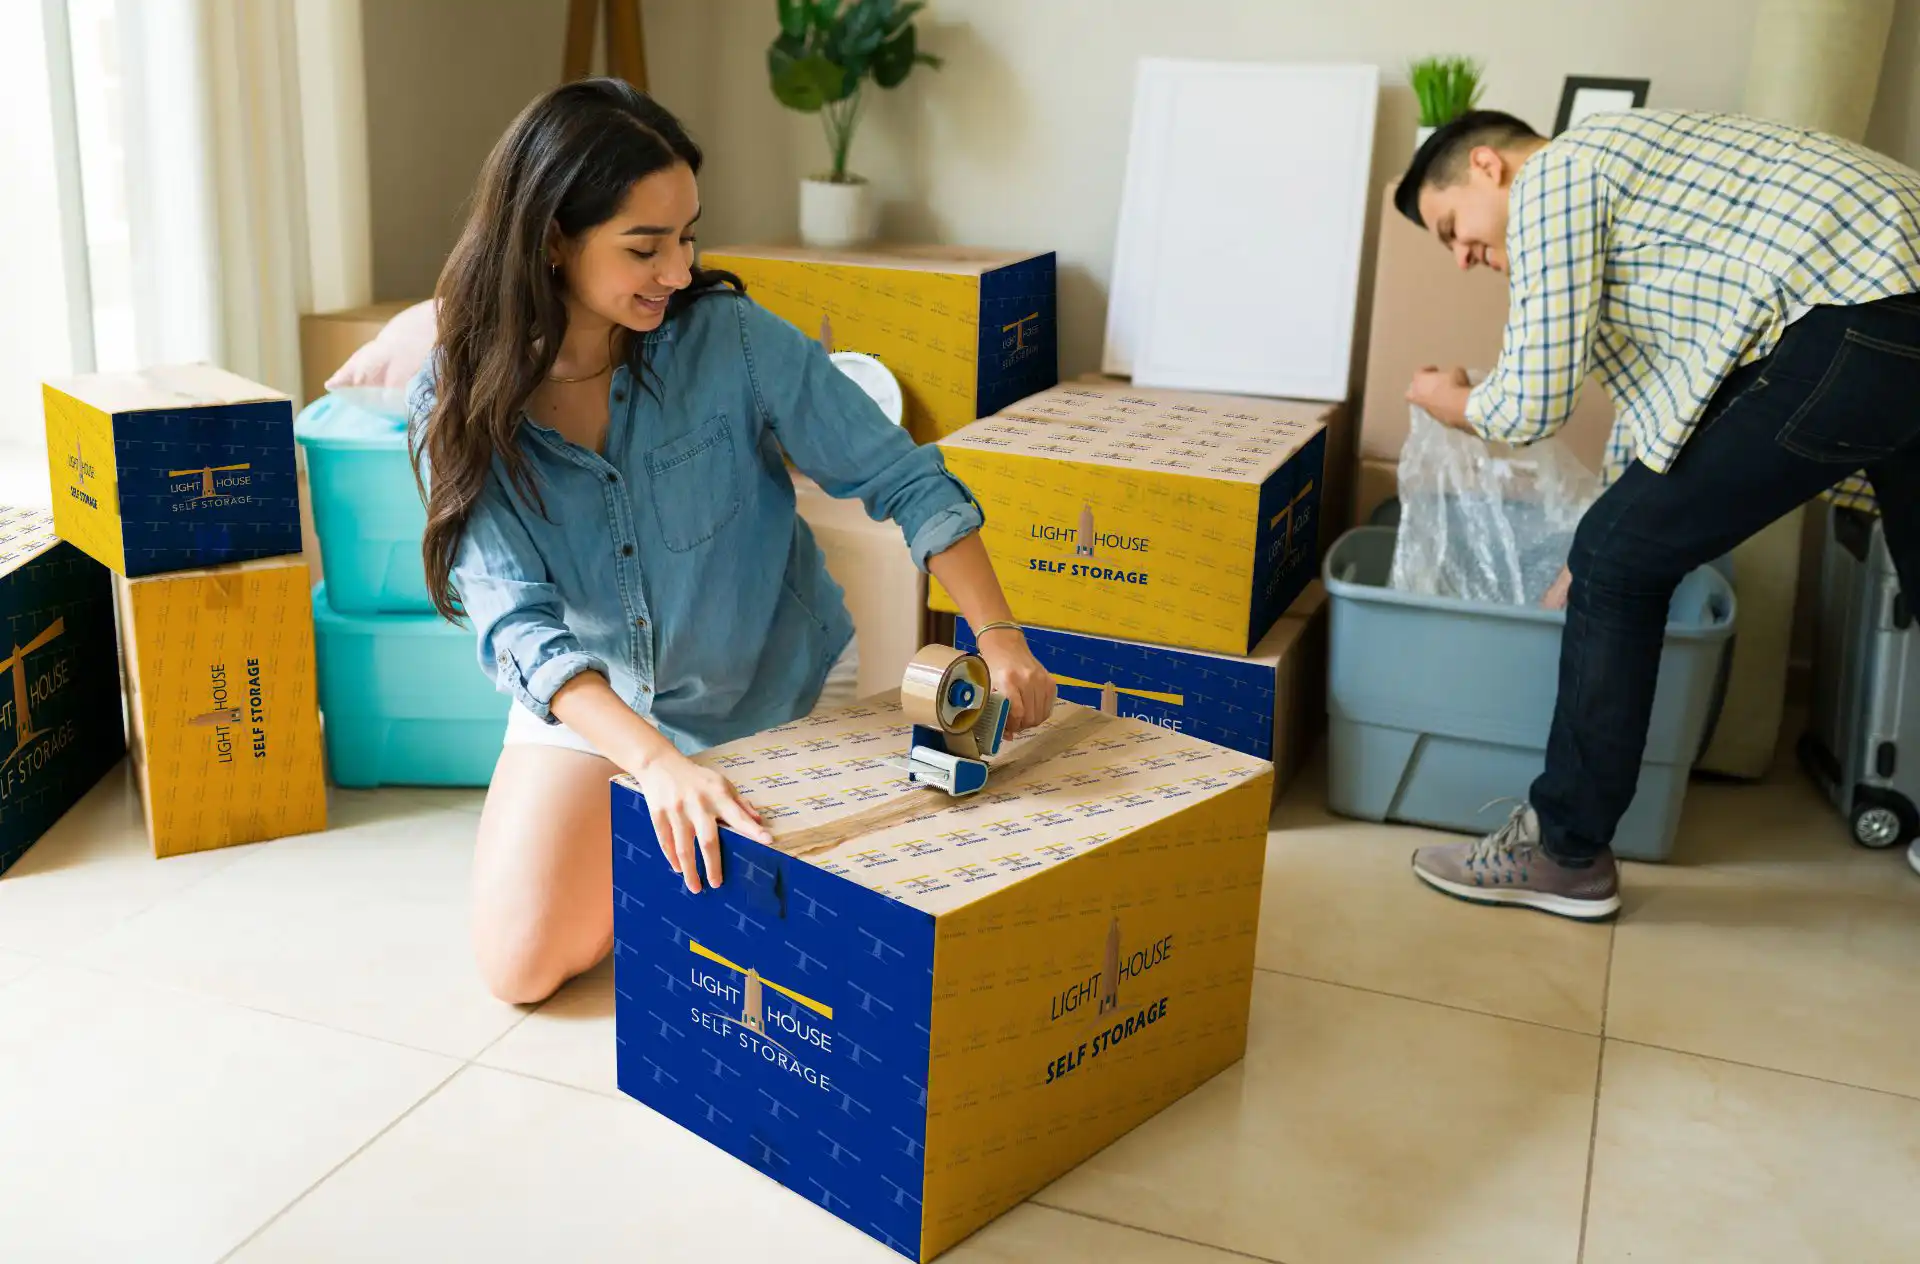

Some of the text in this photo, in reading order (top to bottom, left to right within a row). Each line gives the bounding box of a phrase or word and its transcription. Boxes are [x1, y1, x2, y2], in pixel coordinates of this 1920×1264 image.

[170, 476, 252, 493] LIGHT HOUSE
[172, 495, 253, 512] SELF STORAGE
[1029, 558, 1149, 585] SELF STORAGE
[1031, 524, 1149, 553] LIGHT HOUSE
[30, 659, 70, 709] HOUSE
[211, 663, 233, 763] LIGHT HOUSE
[247, 657, 266, 759] SELF STORAGE
[0, 719, 75, 800] LF STORAGE
[691, 968, 832, 1053] LIGHT HOUSE
[1051, 972, 1102, 1021] LIGHT
[1118, 934, 1173, 985] HOUSE
[691, 1007, 830, 1092] SELF STORAGE
[1045, 1043, 1087, 1084] SELF
[1091, 997, 1169, 1058] STORAGE
